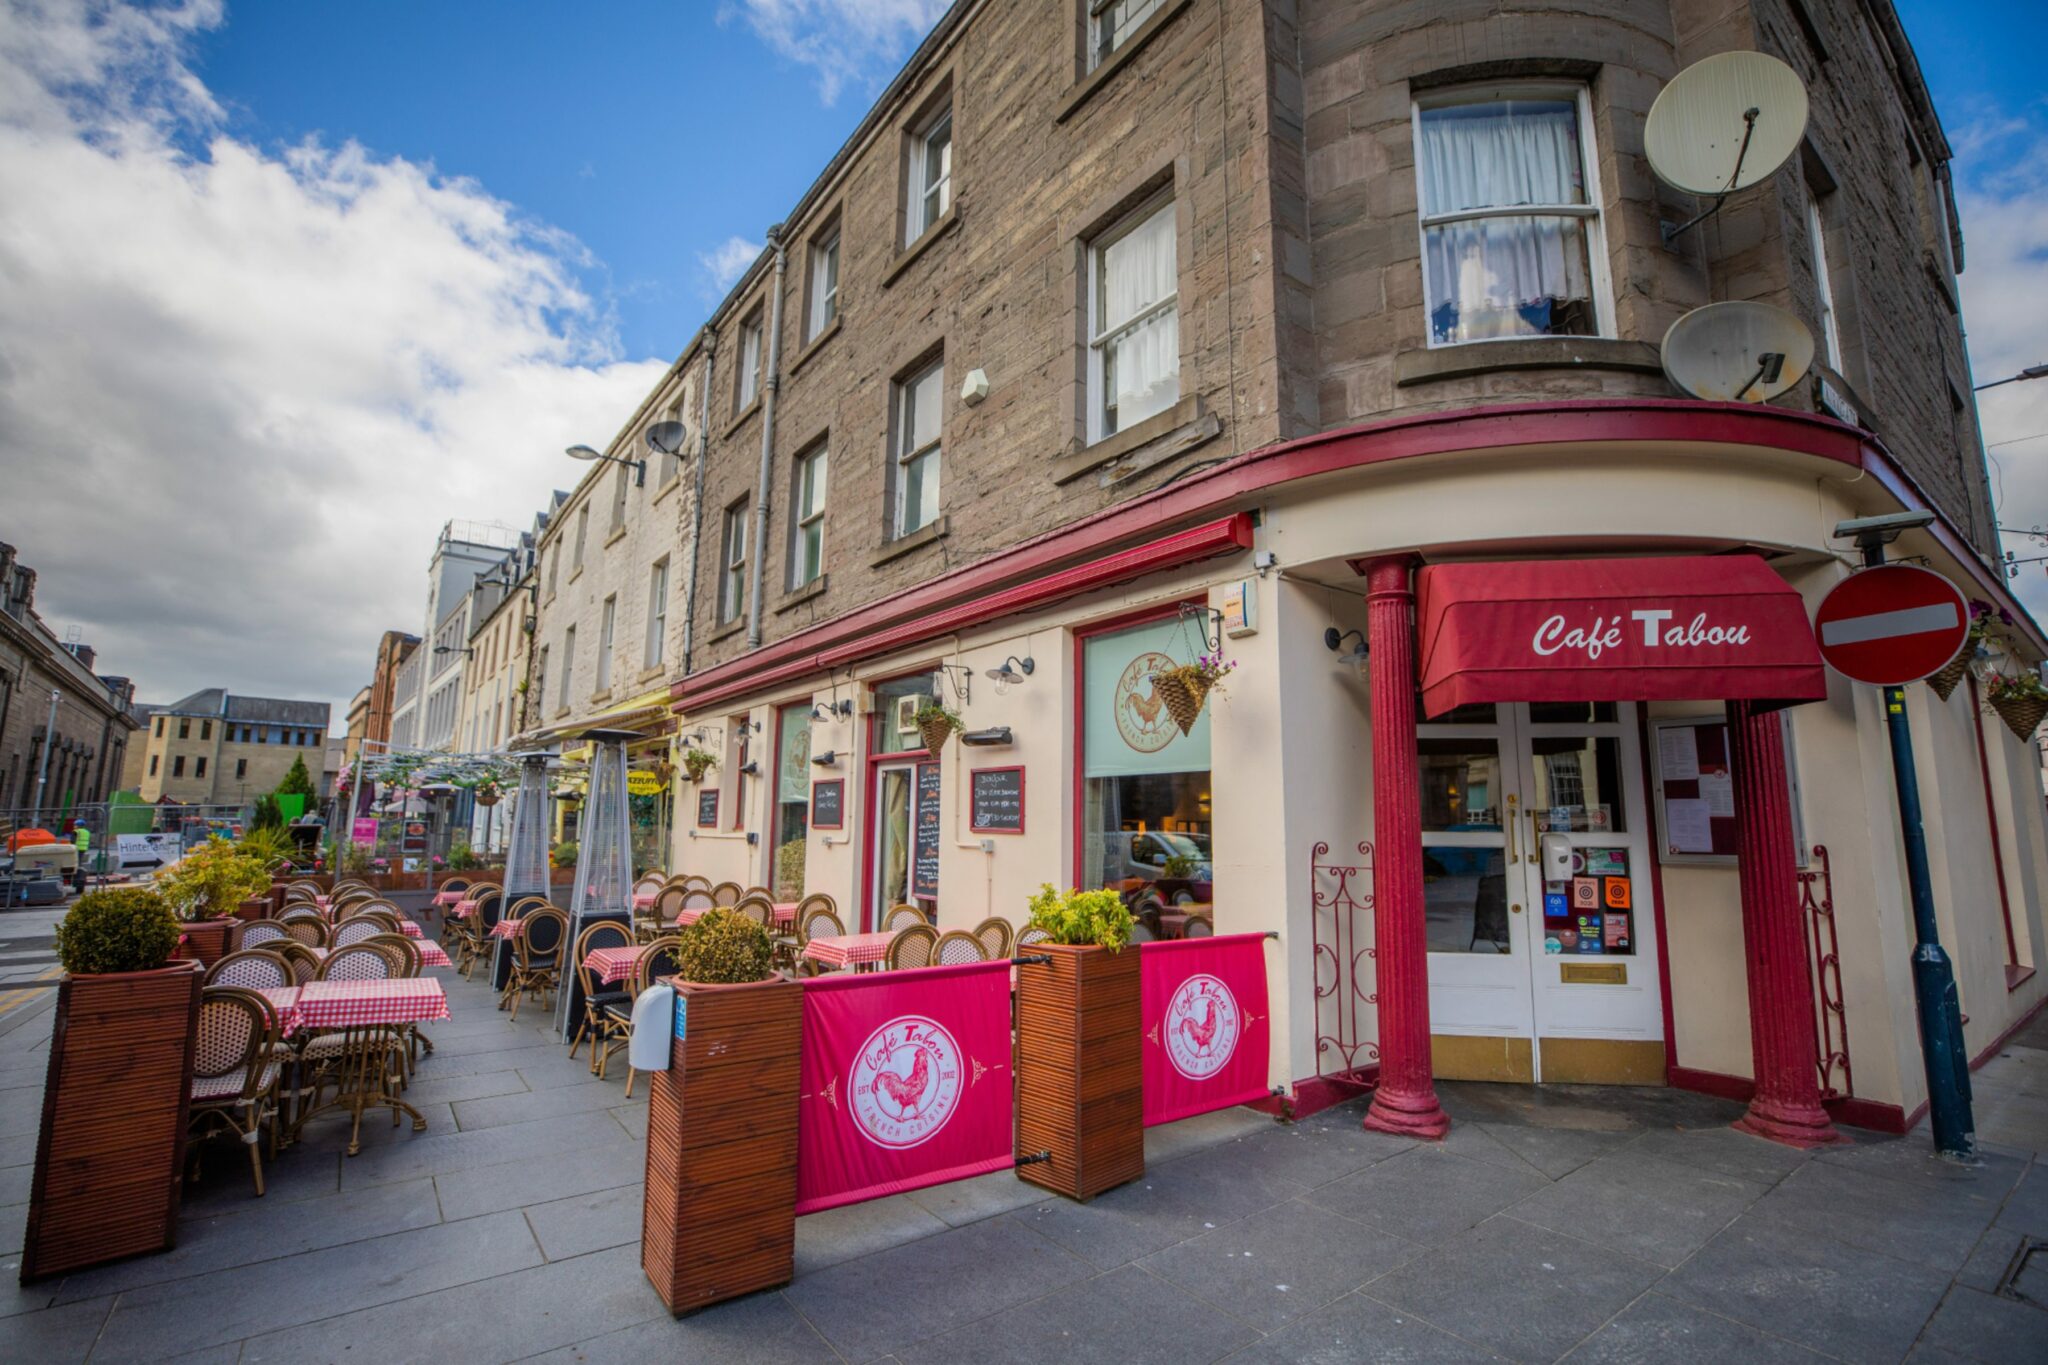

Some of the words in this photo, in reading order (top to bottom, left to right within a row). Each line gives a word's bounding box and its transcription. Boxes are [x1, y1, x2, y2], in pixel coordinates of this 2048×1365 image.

[1532, 614, 1622, 660] Café
[1631, 609, 1751, 647] Tabou
[1174, 986, 1194, 1016] Café
[1200, 982, 1227, 1011] Tabou
[865, 1032, 897, 1071] Café
[904, 1025, 944, 1060] Tabou
[858, 1085, 869, 1095] EST
[864, 1105, 900, 1137] FRENCH
[909, 1095, 950, 1135] CUISINE
